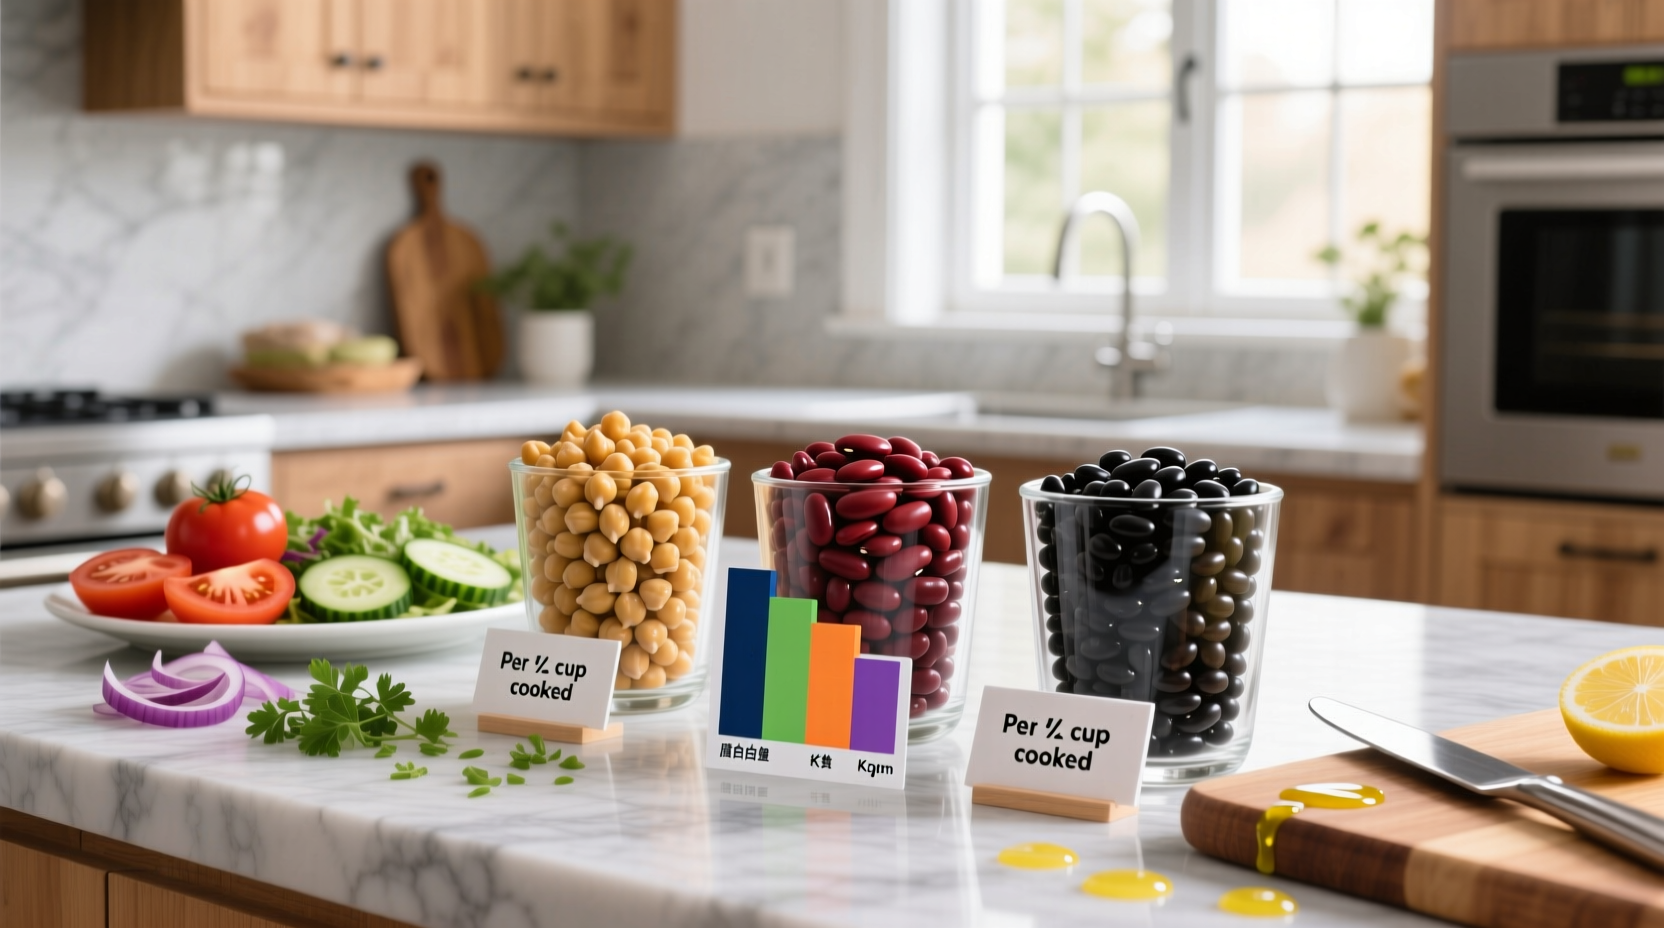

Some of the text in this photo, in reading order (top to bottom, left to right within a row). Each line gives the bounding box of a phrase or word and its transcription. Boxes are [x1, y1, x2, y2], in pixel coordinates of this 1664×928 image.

[500, 651, 529, 672] Per
[555, 662, 587, 682] cup
[510, 681, 574, 701] cooked
[1002, 713, 1039, 736] Per
[1070, 726, 1111, 749] cup
[1014, 747, 1093, 771] cooked
